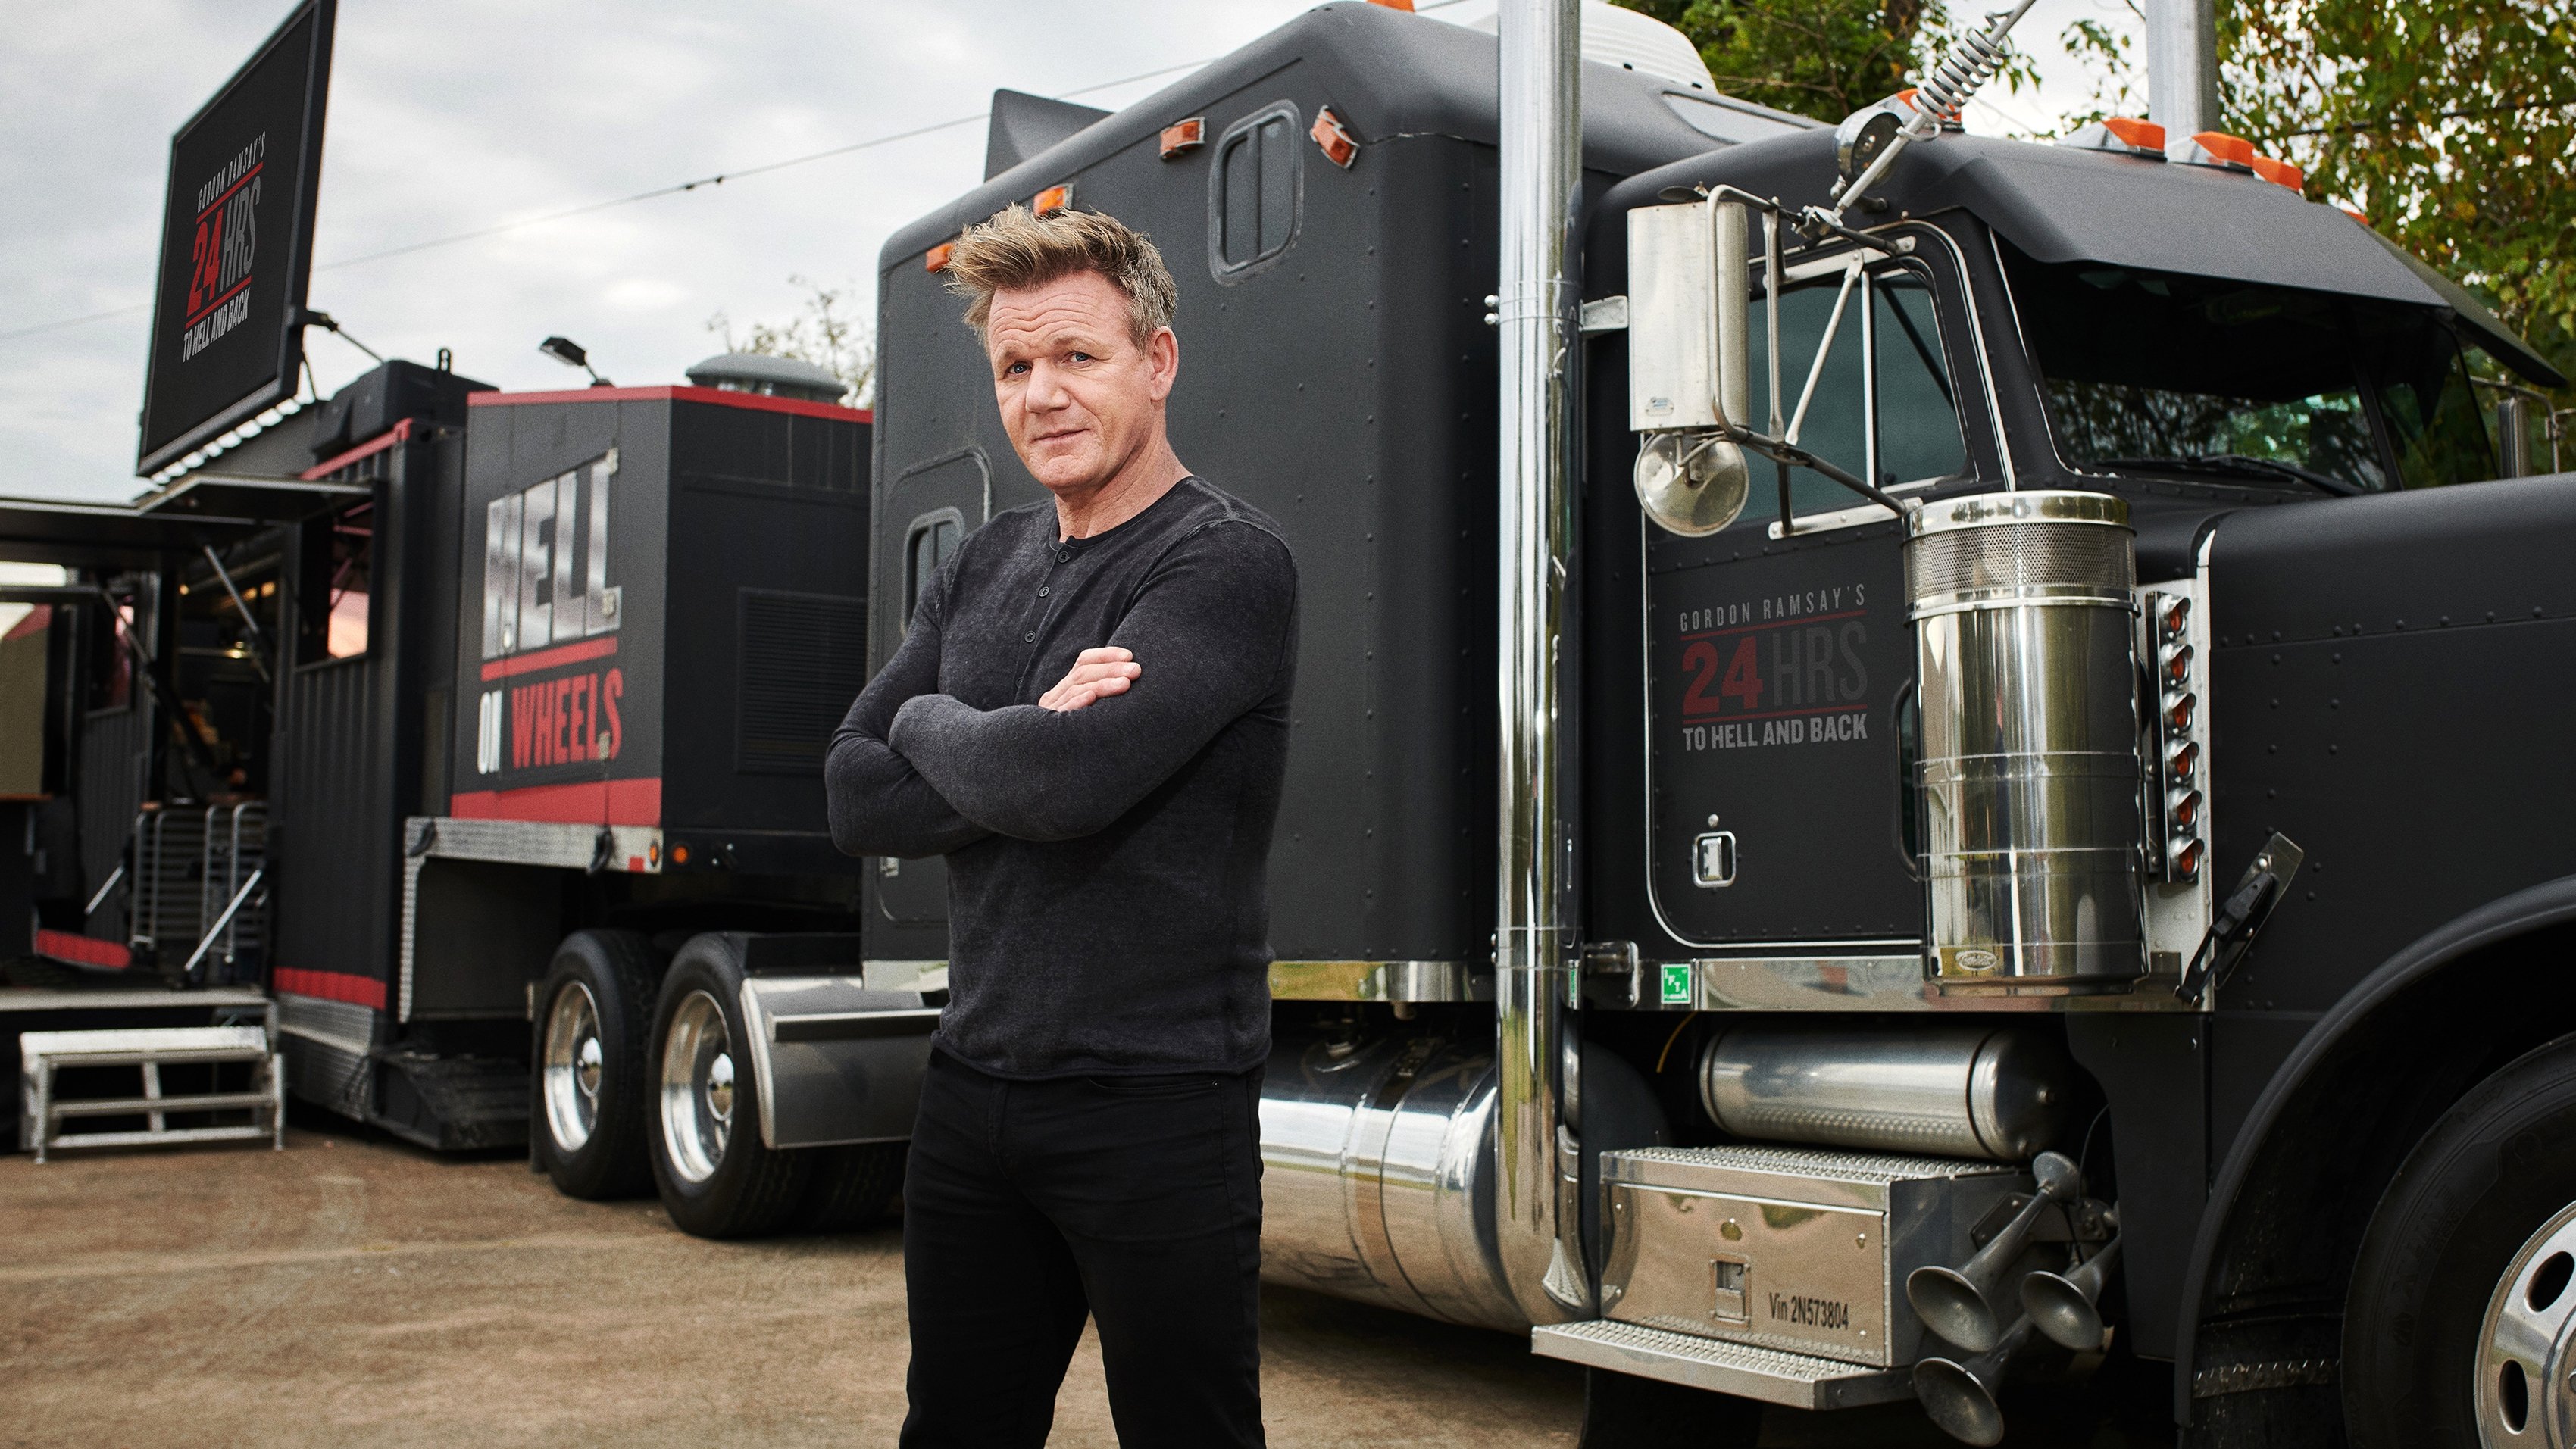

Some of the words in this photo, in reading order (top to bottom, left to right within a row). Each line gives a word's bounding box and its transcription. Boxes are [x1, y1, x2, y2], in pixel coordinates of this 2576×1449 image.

[198, 167, 226, 214] GORDON
[227, 130, 265, 187] RAMSAY'S
[186, 206, 224, 318] 24
[219, 175, 261, 293] HRS
[183, 328, 193, 363] TO
[192, 316, 211, 357] HELL
[210, 304, 228, 344] AND
[227, 286, 251, 333] BACK
[482, 456, 621, 660] HELL
[1680, 602, 1750, 632] GORDON
[1762, 583, 1865, 620] RAMSAY'S
[1681, 635, 1764, 715] 24
[1772, 620, 1868, 707] HRS
[511, 667, 624, 770] WHEELS
[1683, 726, 1706, 751] TO
[1711, 723, 1758, 749] HELL
[1762, 719, 1805, 745] AND
[1809, 713, 1868, 743] BACK
[1768, 1291, 1788, 1321] Vin
[1790, 1295, 1849, 1331] 2N573804
